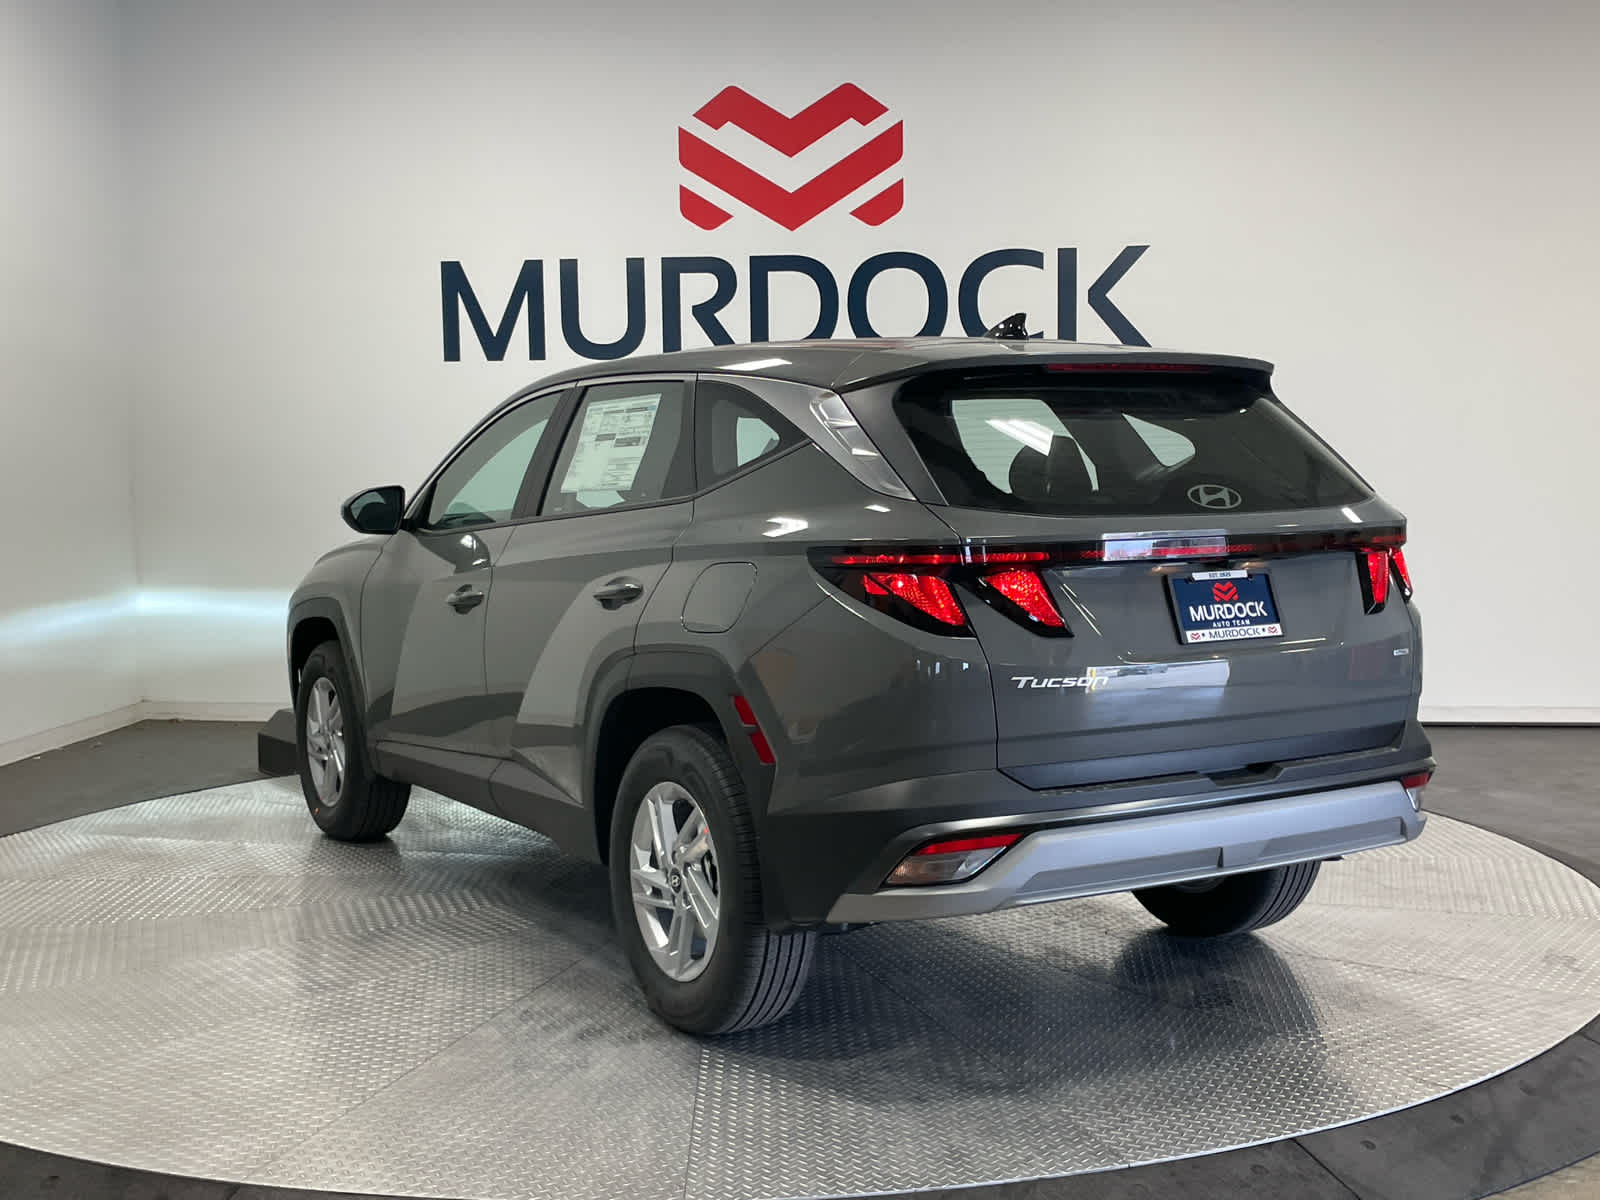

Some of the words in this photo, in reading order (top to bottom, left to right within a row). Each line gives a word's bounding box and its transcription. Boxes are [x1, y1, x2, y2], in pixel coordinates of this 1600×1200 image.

[440, 245, 1151, 362] MURDOCK
[1189, 601, 1268, 622] MURDOCK
[1213, 620, 1231, 628] AUTO
[1233, 618, 1251, 626] TEAM
[1208, 627, 1261, 639] MURDOCK
[1010, 675, 1109, 691] Tucson
